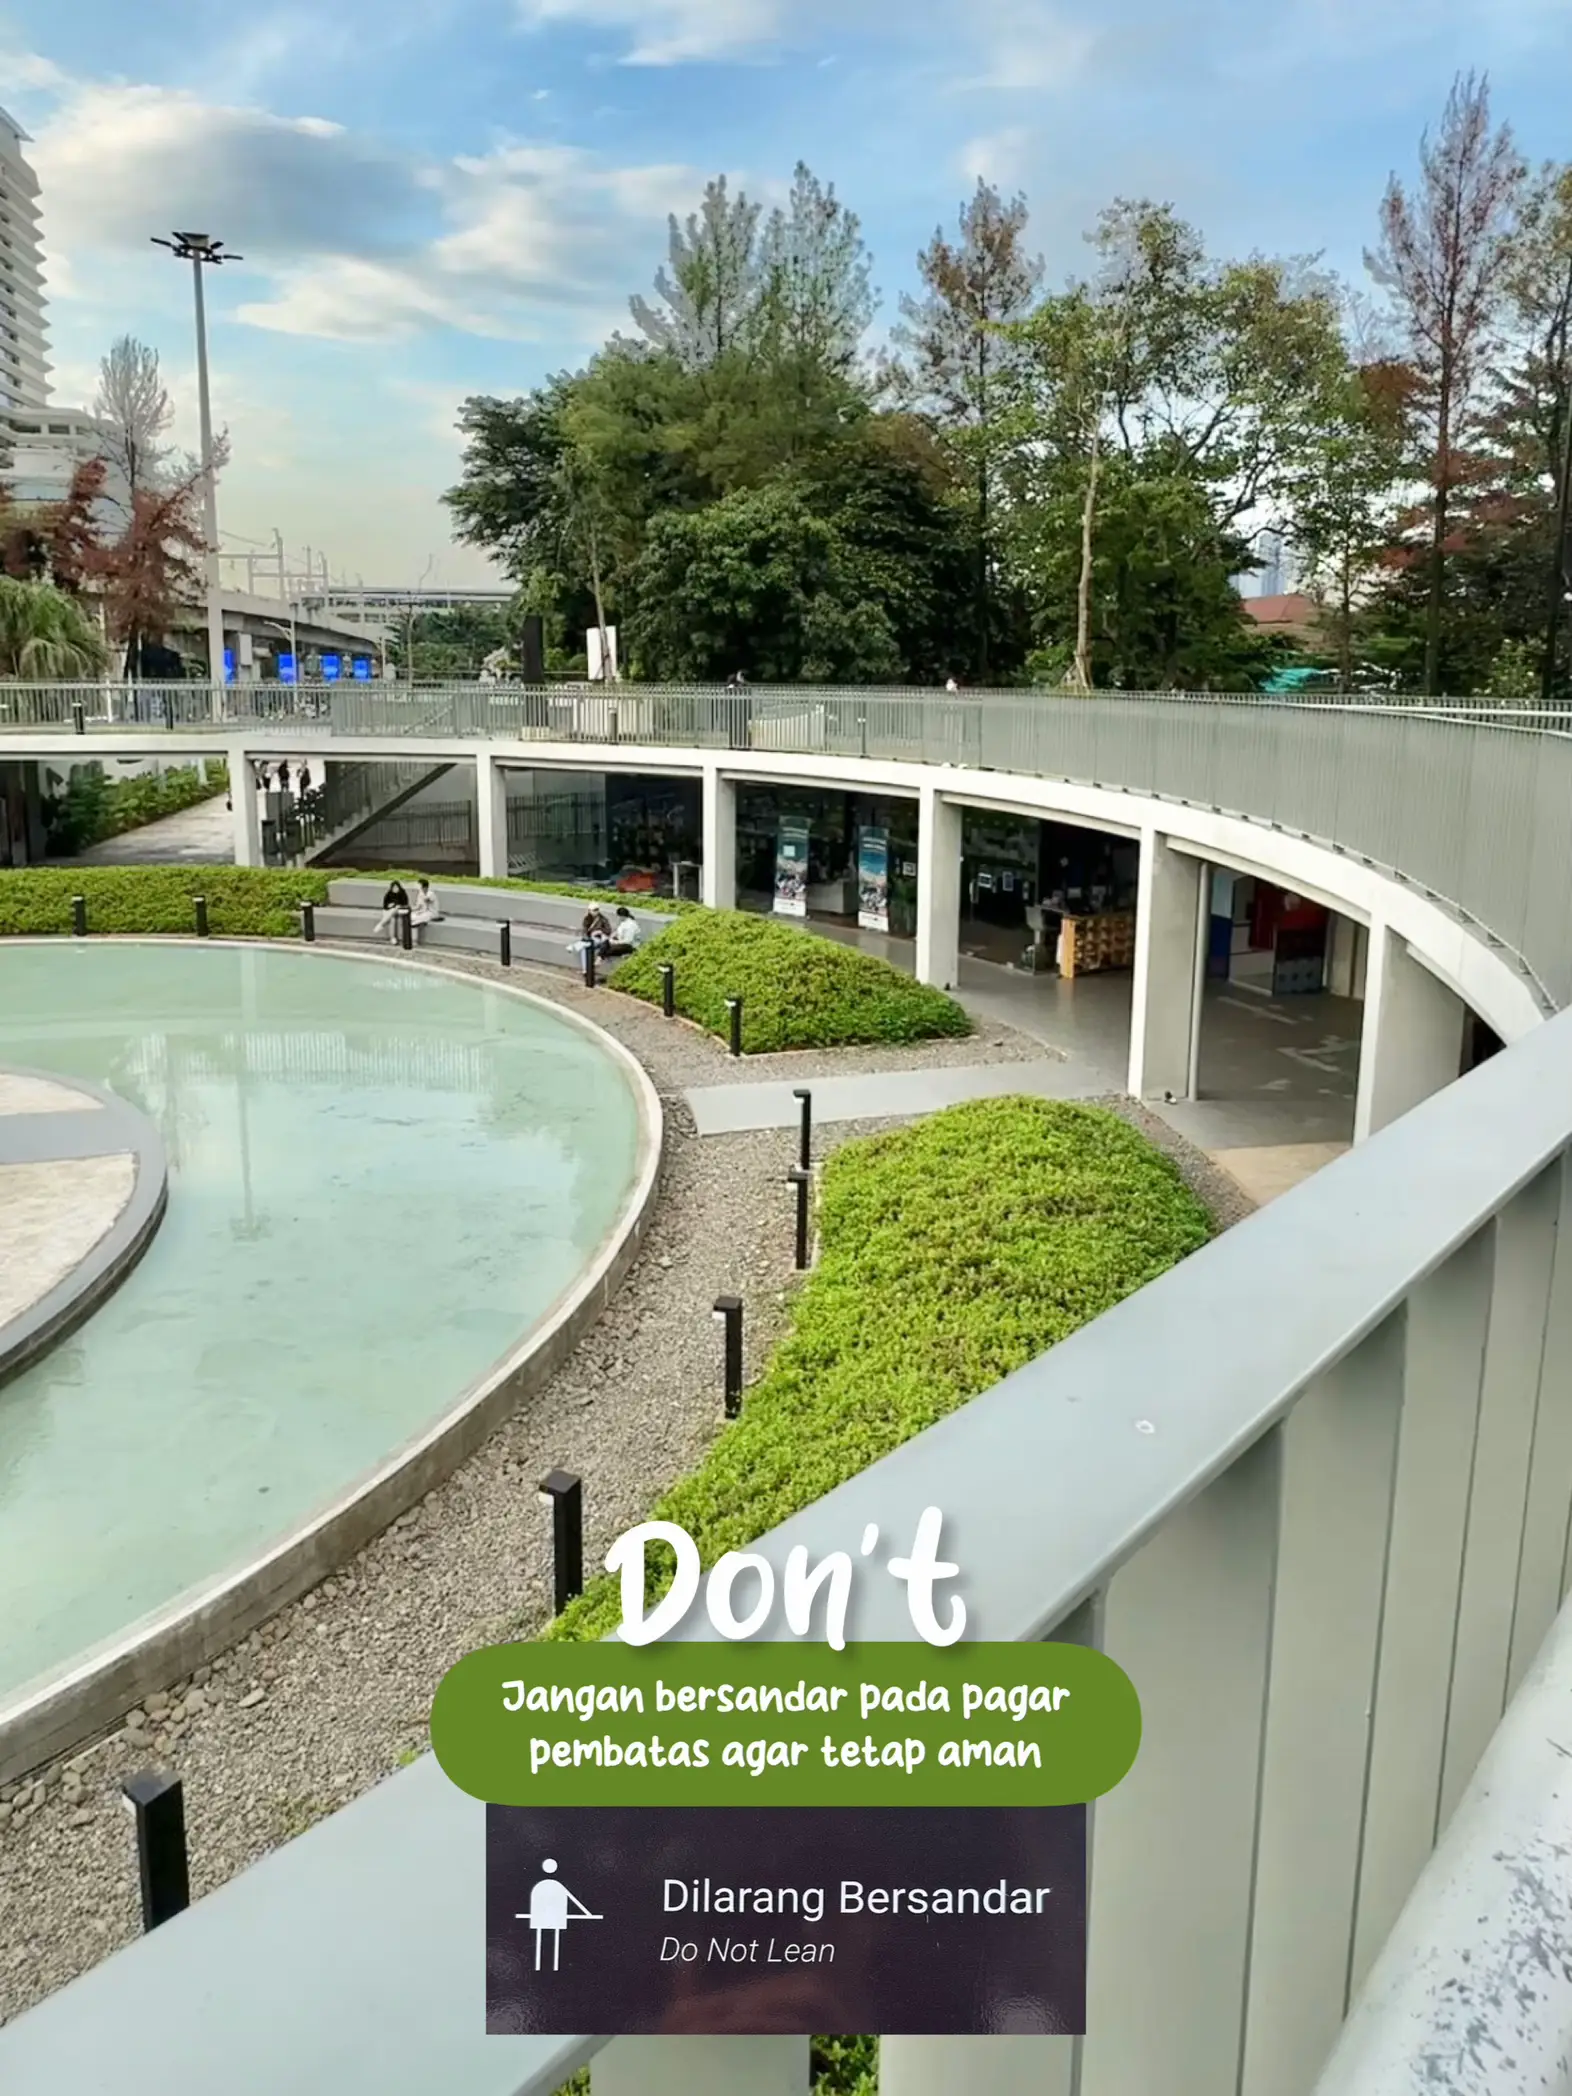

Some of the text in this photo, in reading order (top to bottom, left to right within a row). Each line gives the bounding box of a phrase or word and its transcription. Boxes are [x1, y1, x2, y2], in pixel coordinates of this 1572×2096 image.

[662, 1877, 1050, 1922] Dilarang Bersandar
[660, 1936, 836, 1963] Do Not Lean
